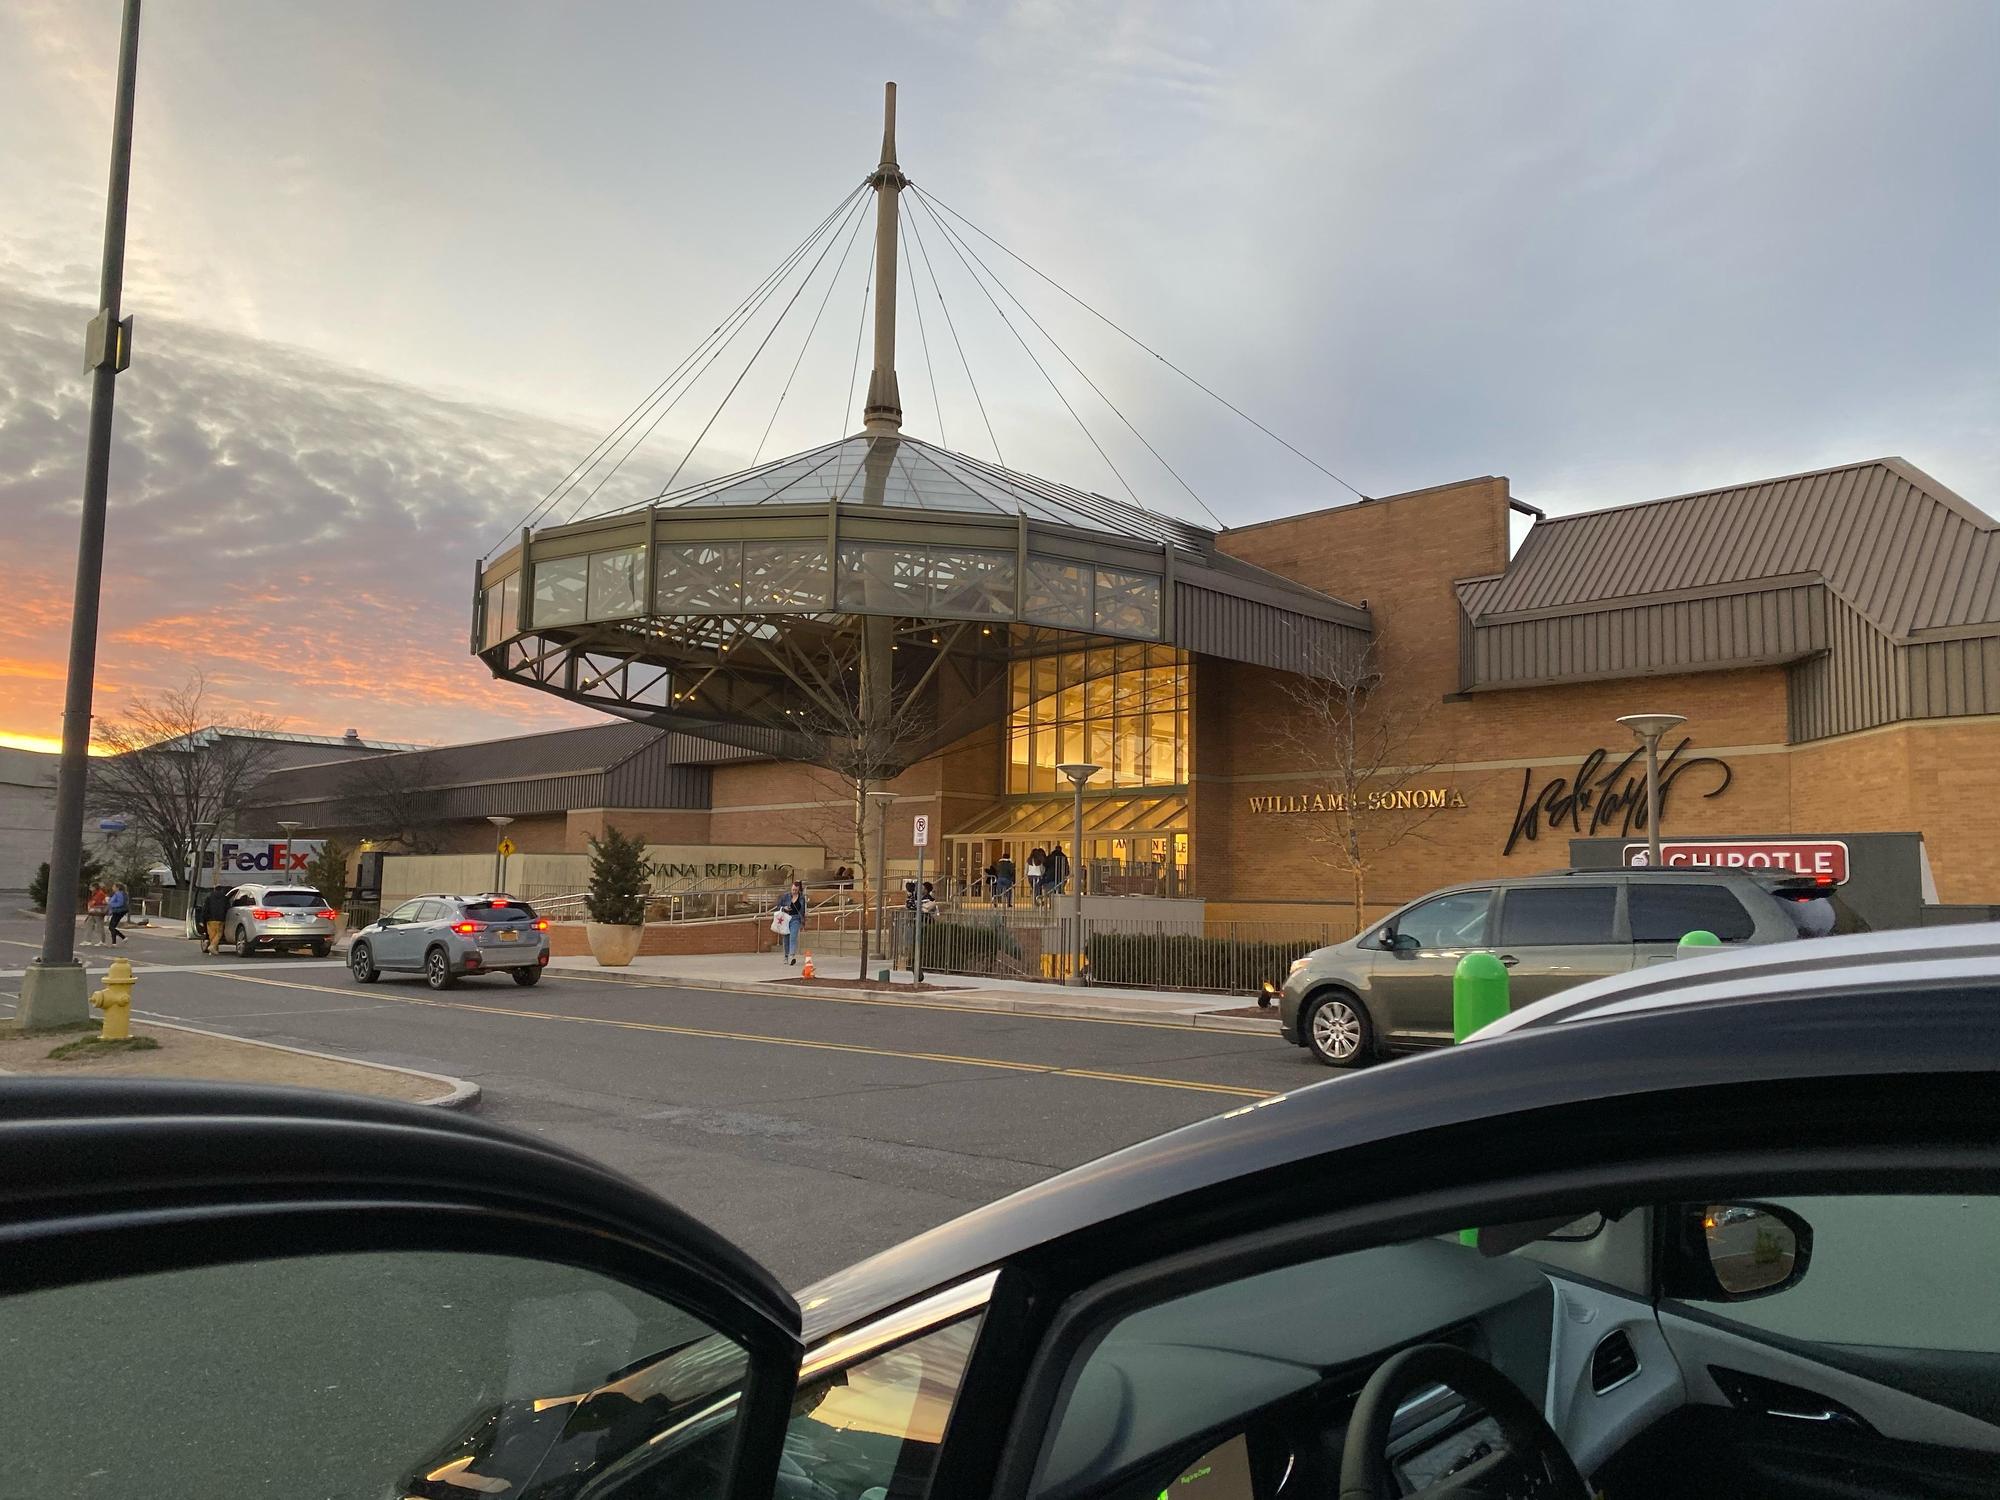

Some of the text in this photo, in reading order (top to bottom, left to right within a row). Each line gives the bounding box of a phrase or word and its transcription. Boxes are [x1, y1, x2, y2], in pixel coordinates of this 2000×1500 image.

[221, 843, 309, 871] FedEx
[1669, 852, 1833, 873] CHIPOTLE
[642, 863, 697, 878] NANA
